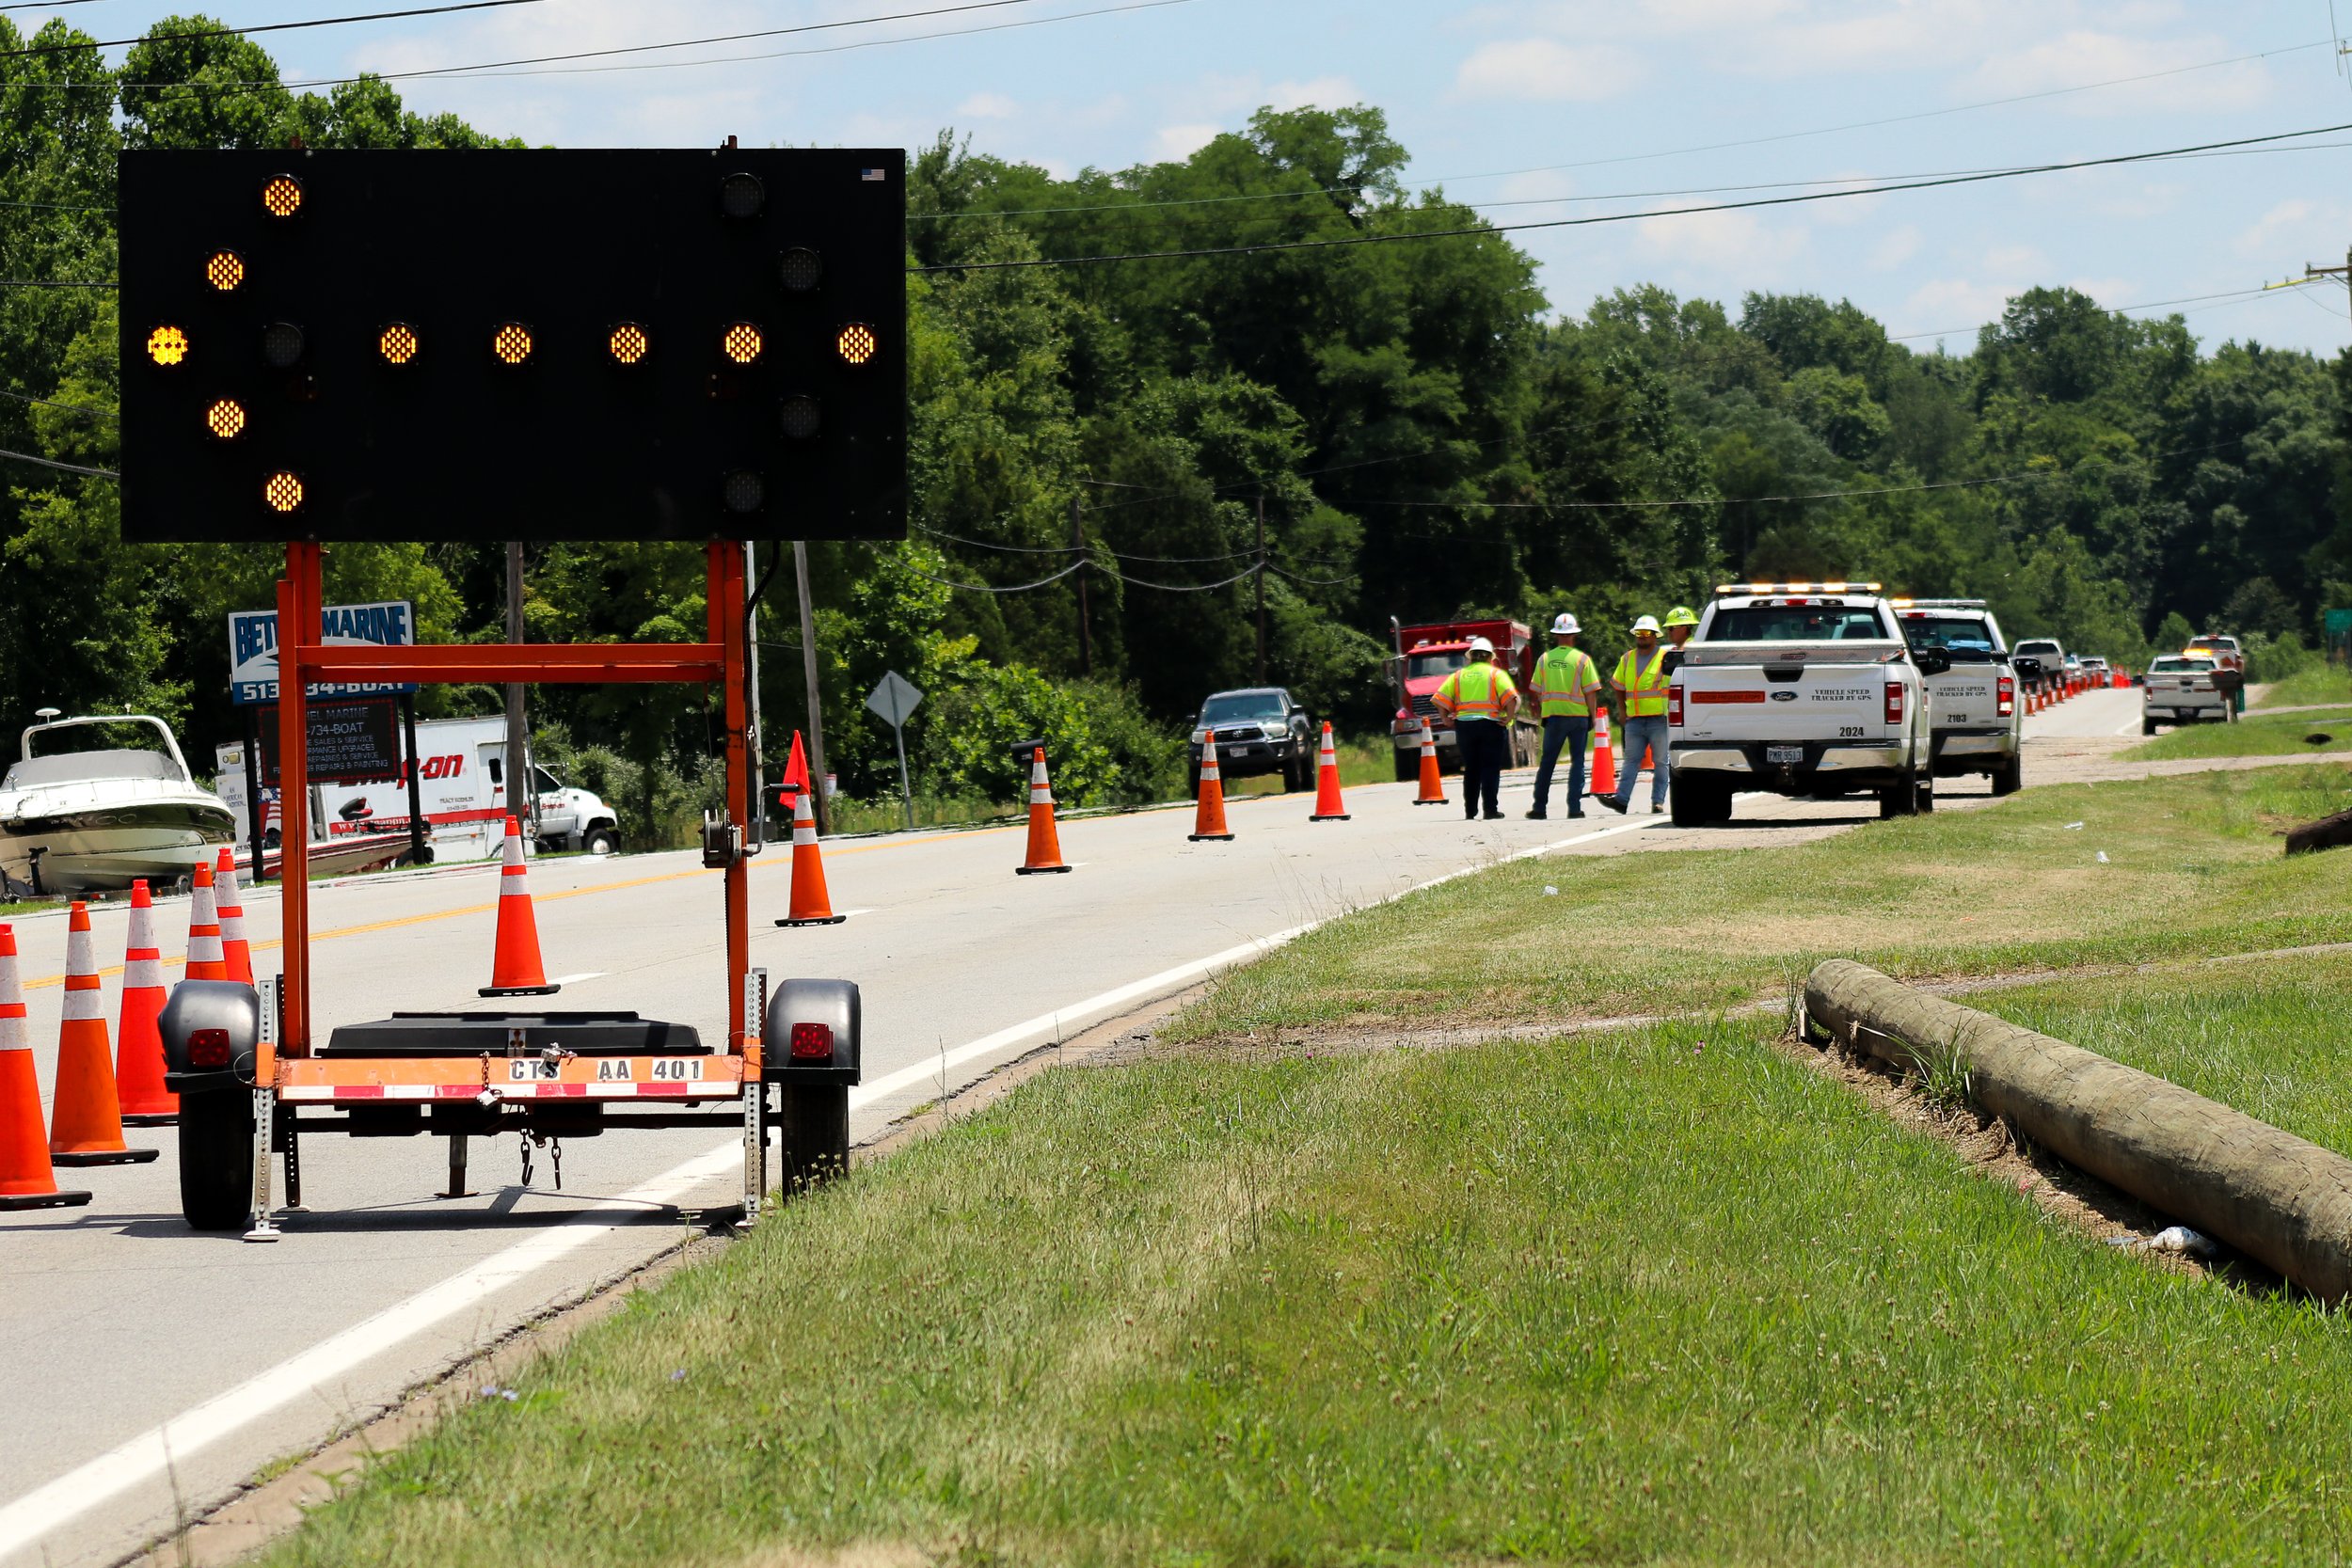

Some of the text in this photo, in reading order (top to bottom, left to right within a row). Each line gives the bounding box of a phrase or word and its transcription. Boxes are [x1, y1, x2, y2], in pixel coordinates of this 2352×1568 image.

[321, 605, 407, 647] MARINE
[1947, 714, 1967, 723] 2103
[306, 721, 364, 736] -734-BOAT
[1839, 726, 1865, 737] 2024
[1784, 751, 1802, 761] 9513
[511, 1060, 700, 1079] CTS AA 401
